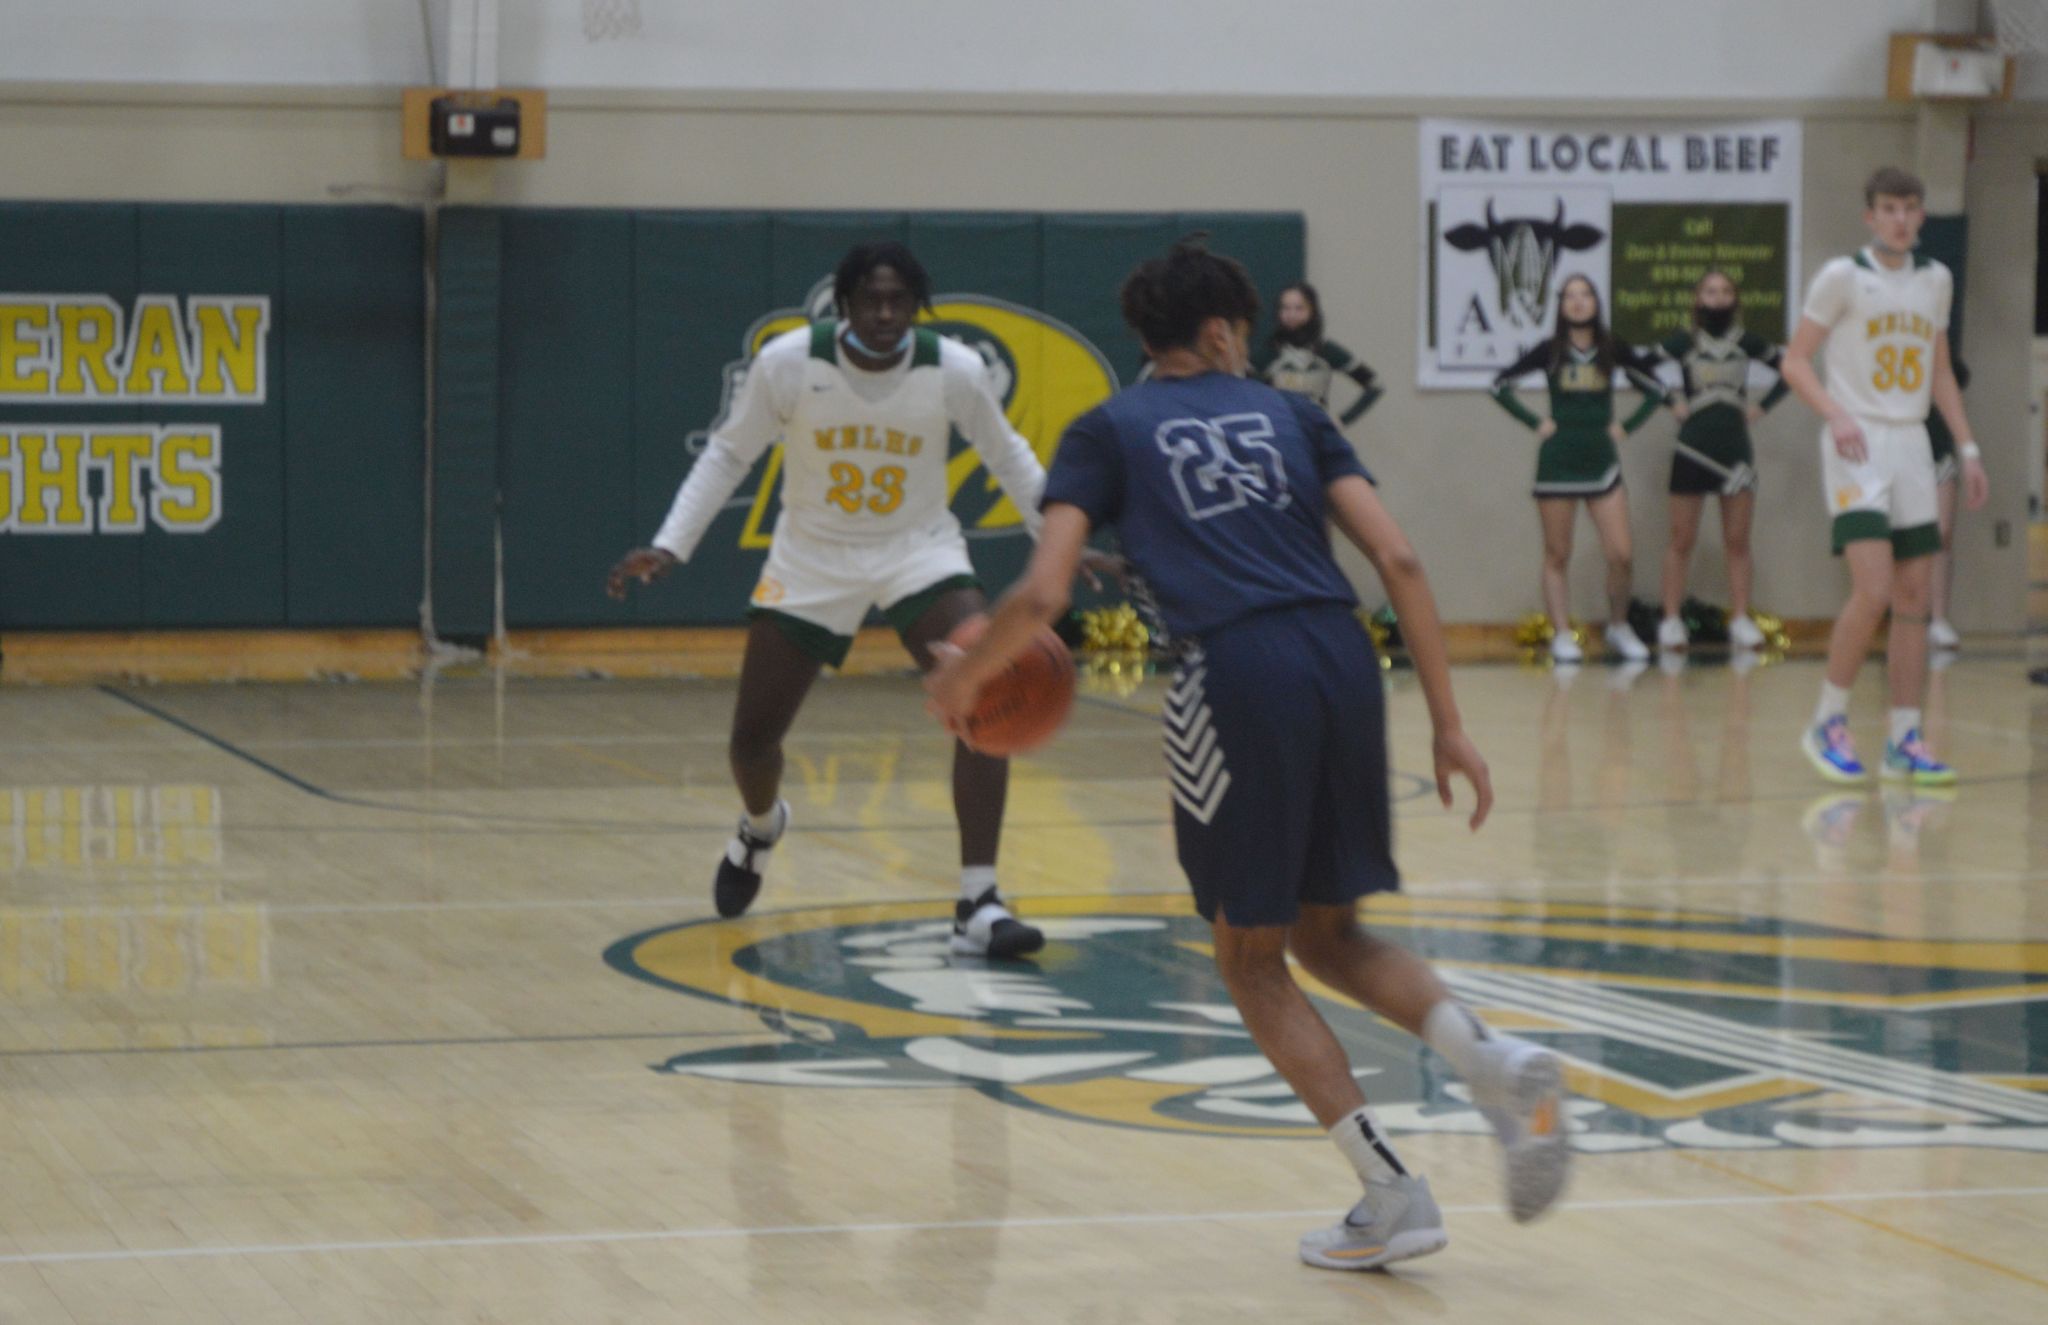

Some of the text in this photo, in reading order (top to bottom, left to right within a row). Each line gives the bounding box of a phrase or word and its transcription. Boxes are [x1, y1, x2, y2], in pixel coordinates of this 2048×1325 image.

[1440, 134, 1779, 172] EAT LOCAL BEEF
[0, 295, 270, 403] ERAN
[0, 423, 222, 534] HTS
[826, 459, 907, 514] 23
[1155, 412, 1293, 521] 25
